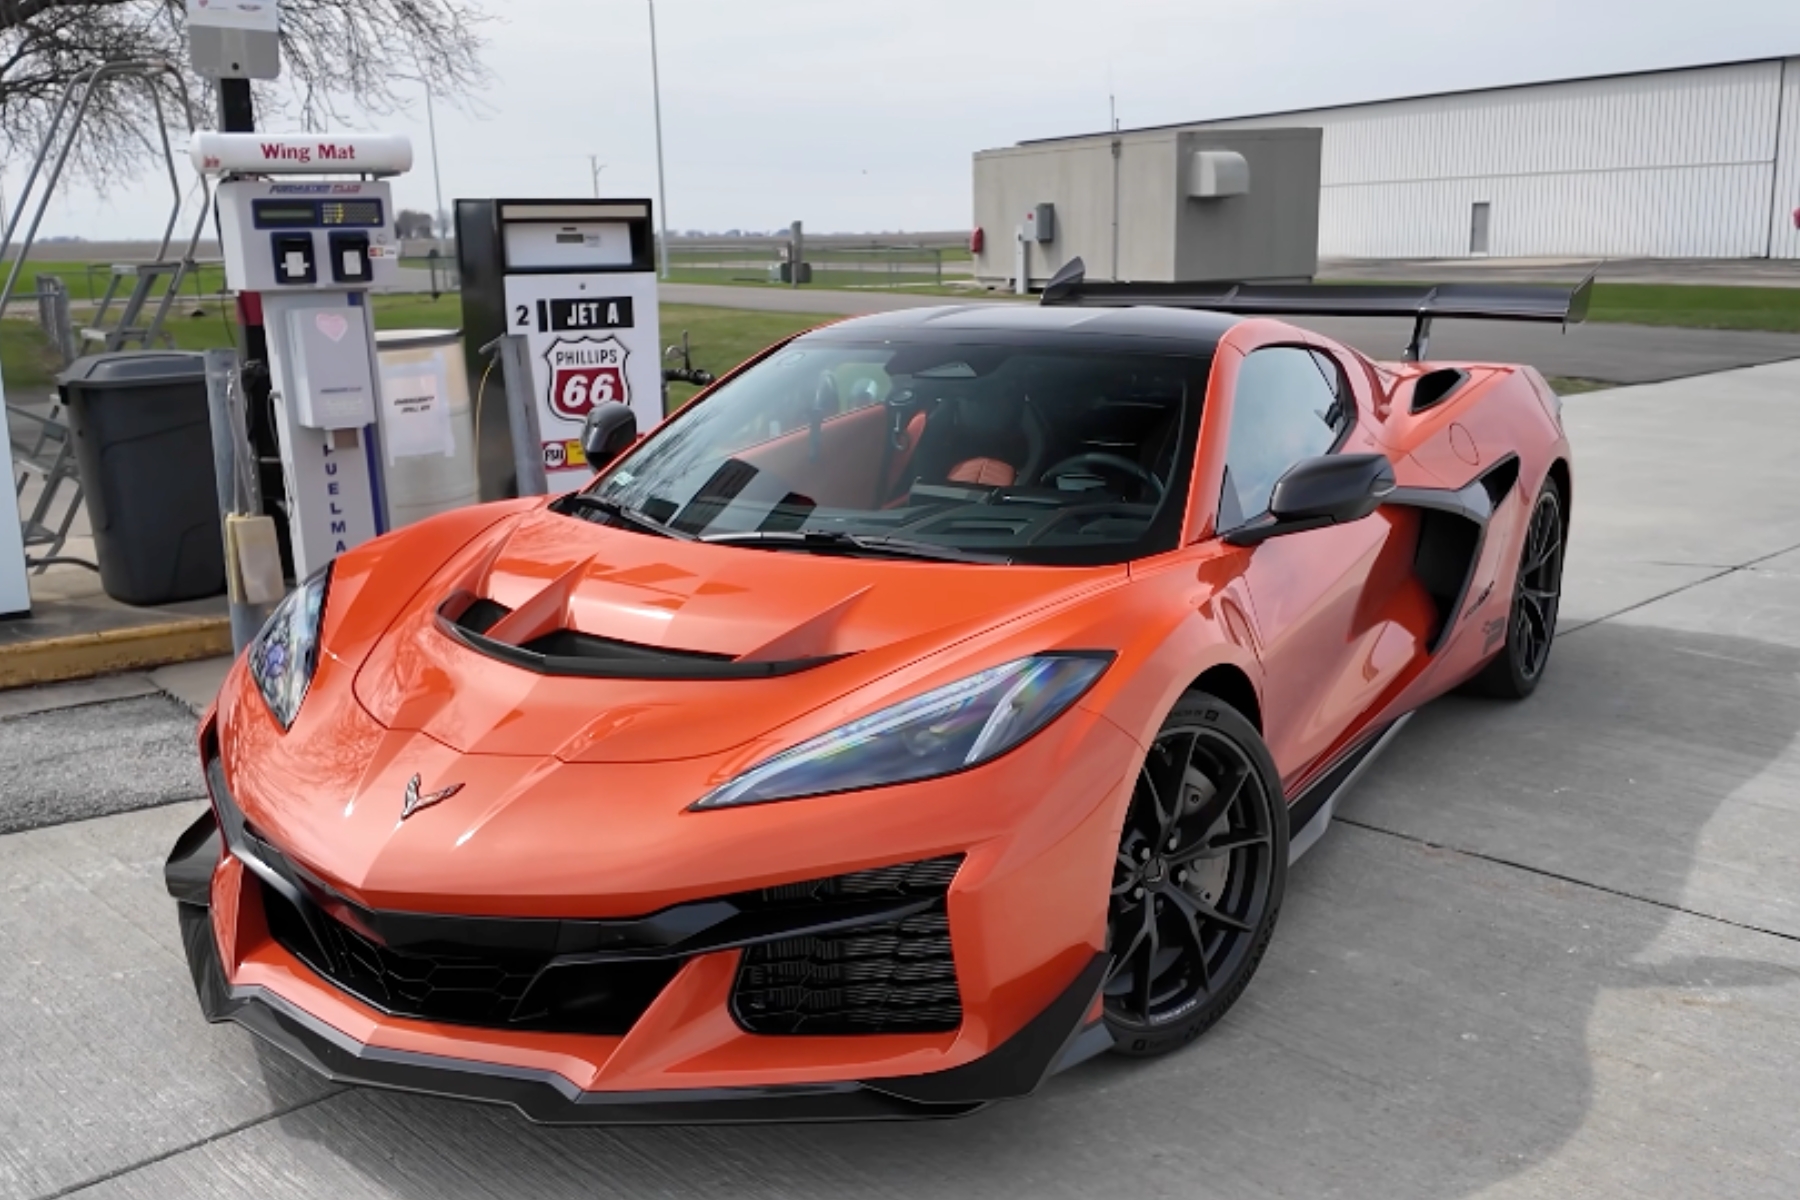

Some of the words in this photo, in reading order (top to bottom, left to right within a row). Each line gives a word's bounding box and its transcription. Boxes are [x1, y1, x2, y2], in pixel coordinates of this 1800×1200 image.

[260, 142, 311, 163] Wing
[318, 143, 355, 160] Mat
[516, 305, 530, 326] 2
[566, 303, 599, 326] JET
[606, 302, 619, 324] A
[556, 348, 618, 365] PHILLIPS
[562, 373, 615, 408] 66
